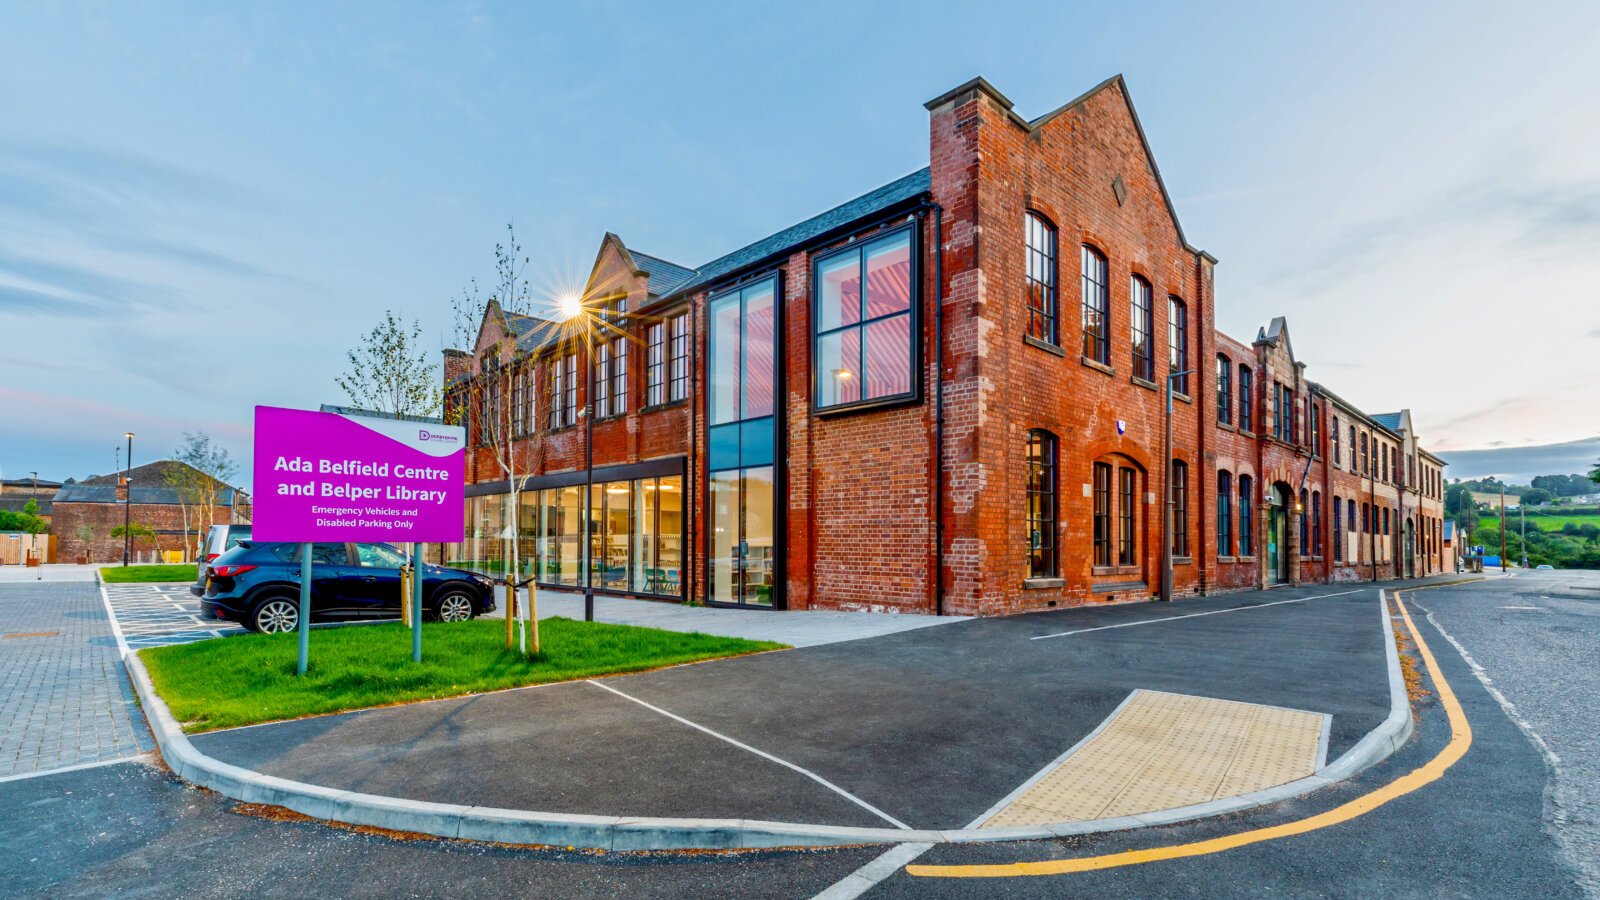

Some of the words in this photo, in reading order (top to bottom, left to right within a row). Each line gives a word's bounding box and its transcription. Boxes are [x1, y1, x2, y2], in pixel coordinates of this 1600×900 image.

[274, 456, 312, 472] Ada
[319, 460, 389, 477] Belfield
[394, 465, 449, 480] Centre
[278, 482, 315, 496] and
[321, 483, 382, 501] Belper
[386, 486, 447, 504] Library
[312, 506, 364, 516] Emergency
[364, 507, 400, 516] Vehicles
[316, 518, 356, 527] Disabled
[358, 520, 392, 529] Parking
[394, 520, 414, 530] Only
